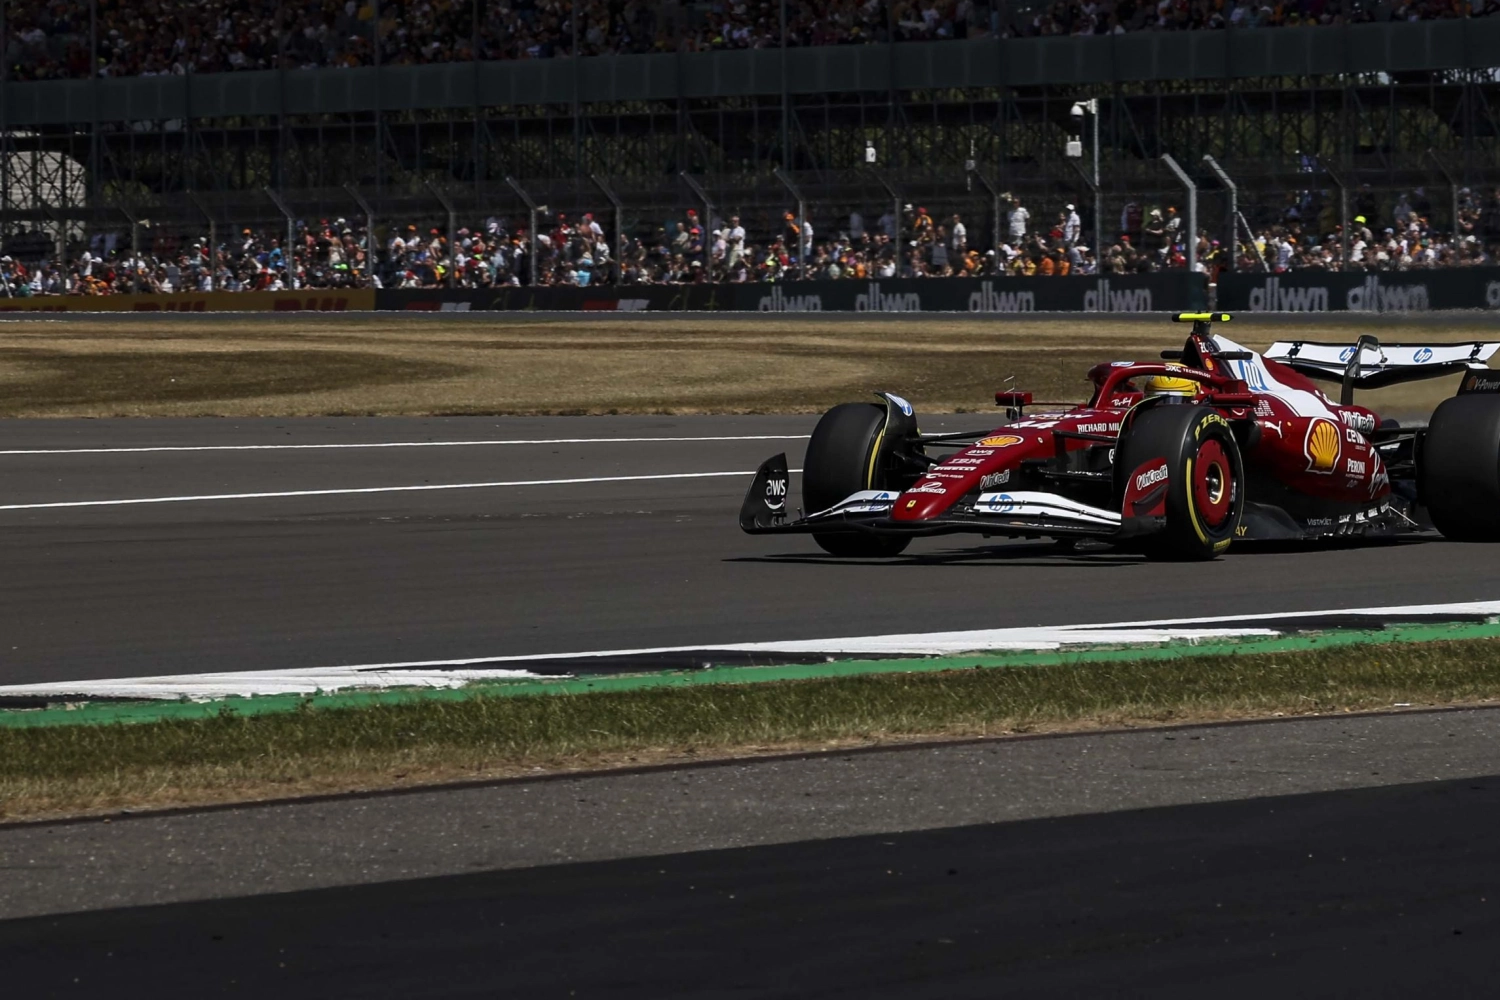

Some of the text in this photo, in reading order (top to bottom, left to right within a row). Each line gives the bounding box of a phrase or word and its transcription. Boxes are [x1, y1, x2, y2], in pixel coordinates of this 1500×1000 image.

[759, 286, 821, 312] allwyn
[855, 282, 920, 312] allwyn
[969, 281, 1034, 312] allwyn
[1084, 278, 1151, 312] allwyn
[1250, 277, 1329, 312] allwyn
[1347, 275, 1428, 314] allwyn
[1413, 348, 1433, 363] hp
[1165, 365, 1183, 373] DXC
[1077, 423, 1120, 434] RICHARD MIL
[1195, 414, 1228, 440] P ZERO
[1142, 464, 1168, 487] UniCredit
[1347, 459, 1365, 474] PERONI
[766, 479, 786, 496] aws
[988, 494, 1014, 512] hp
